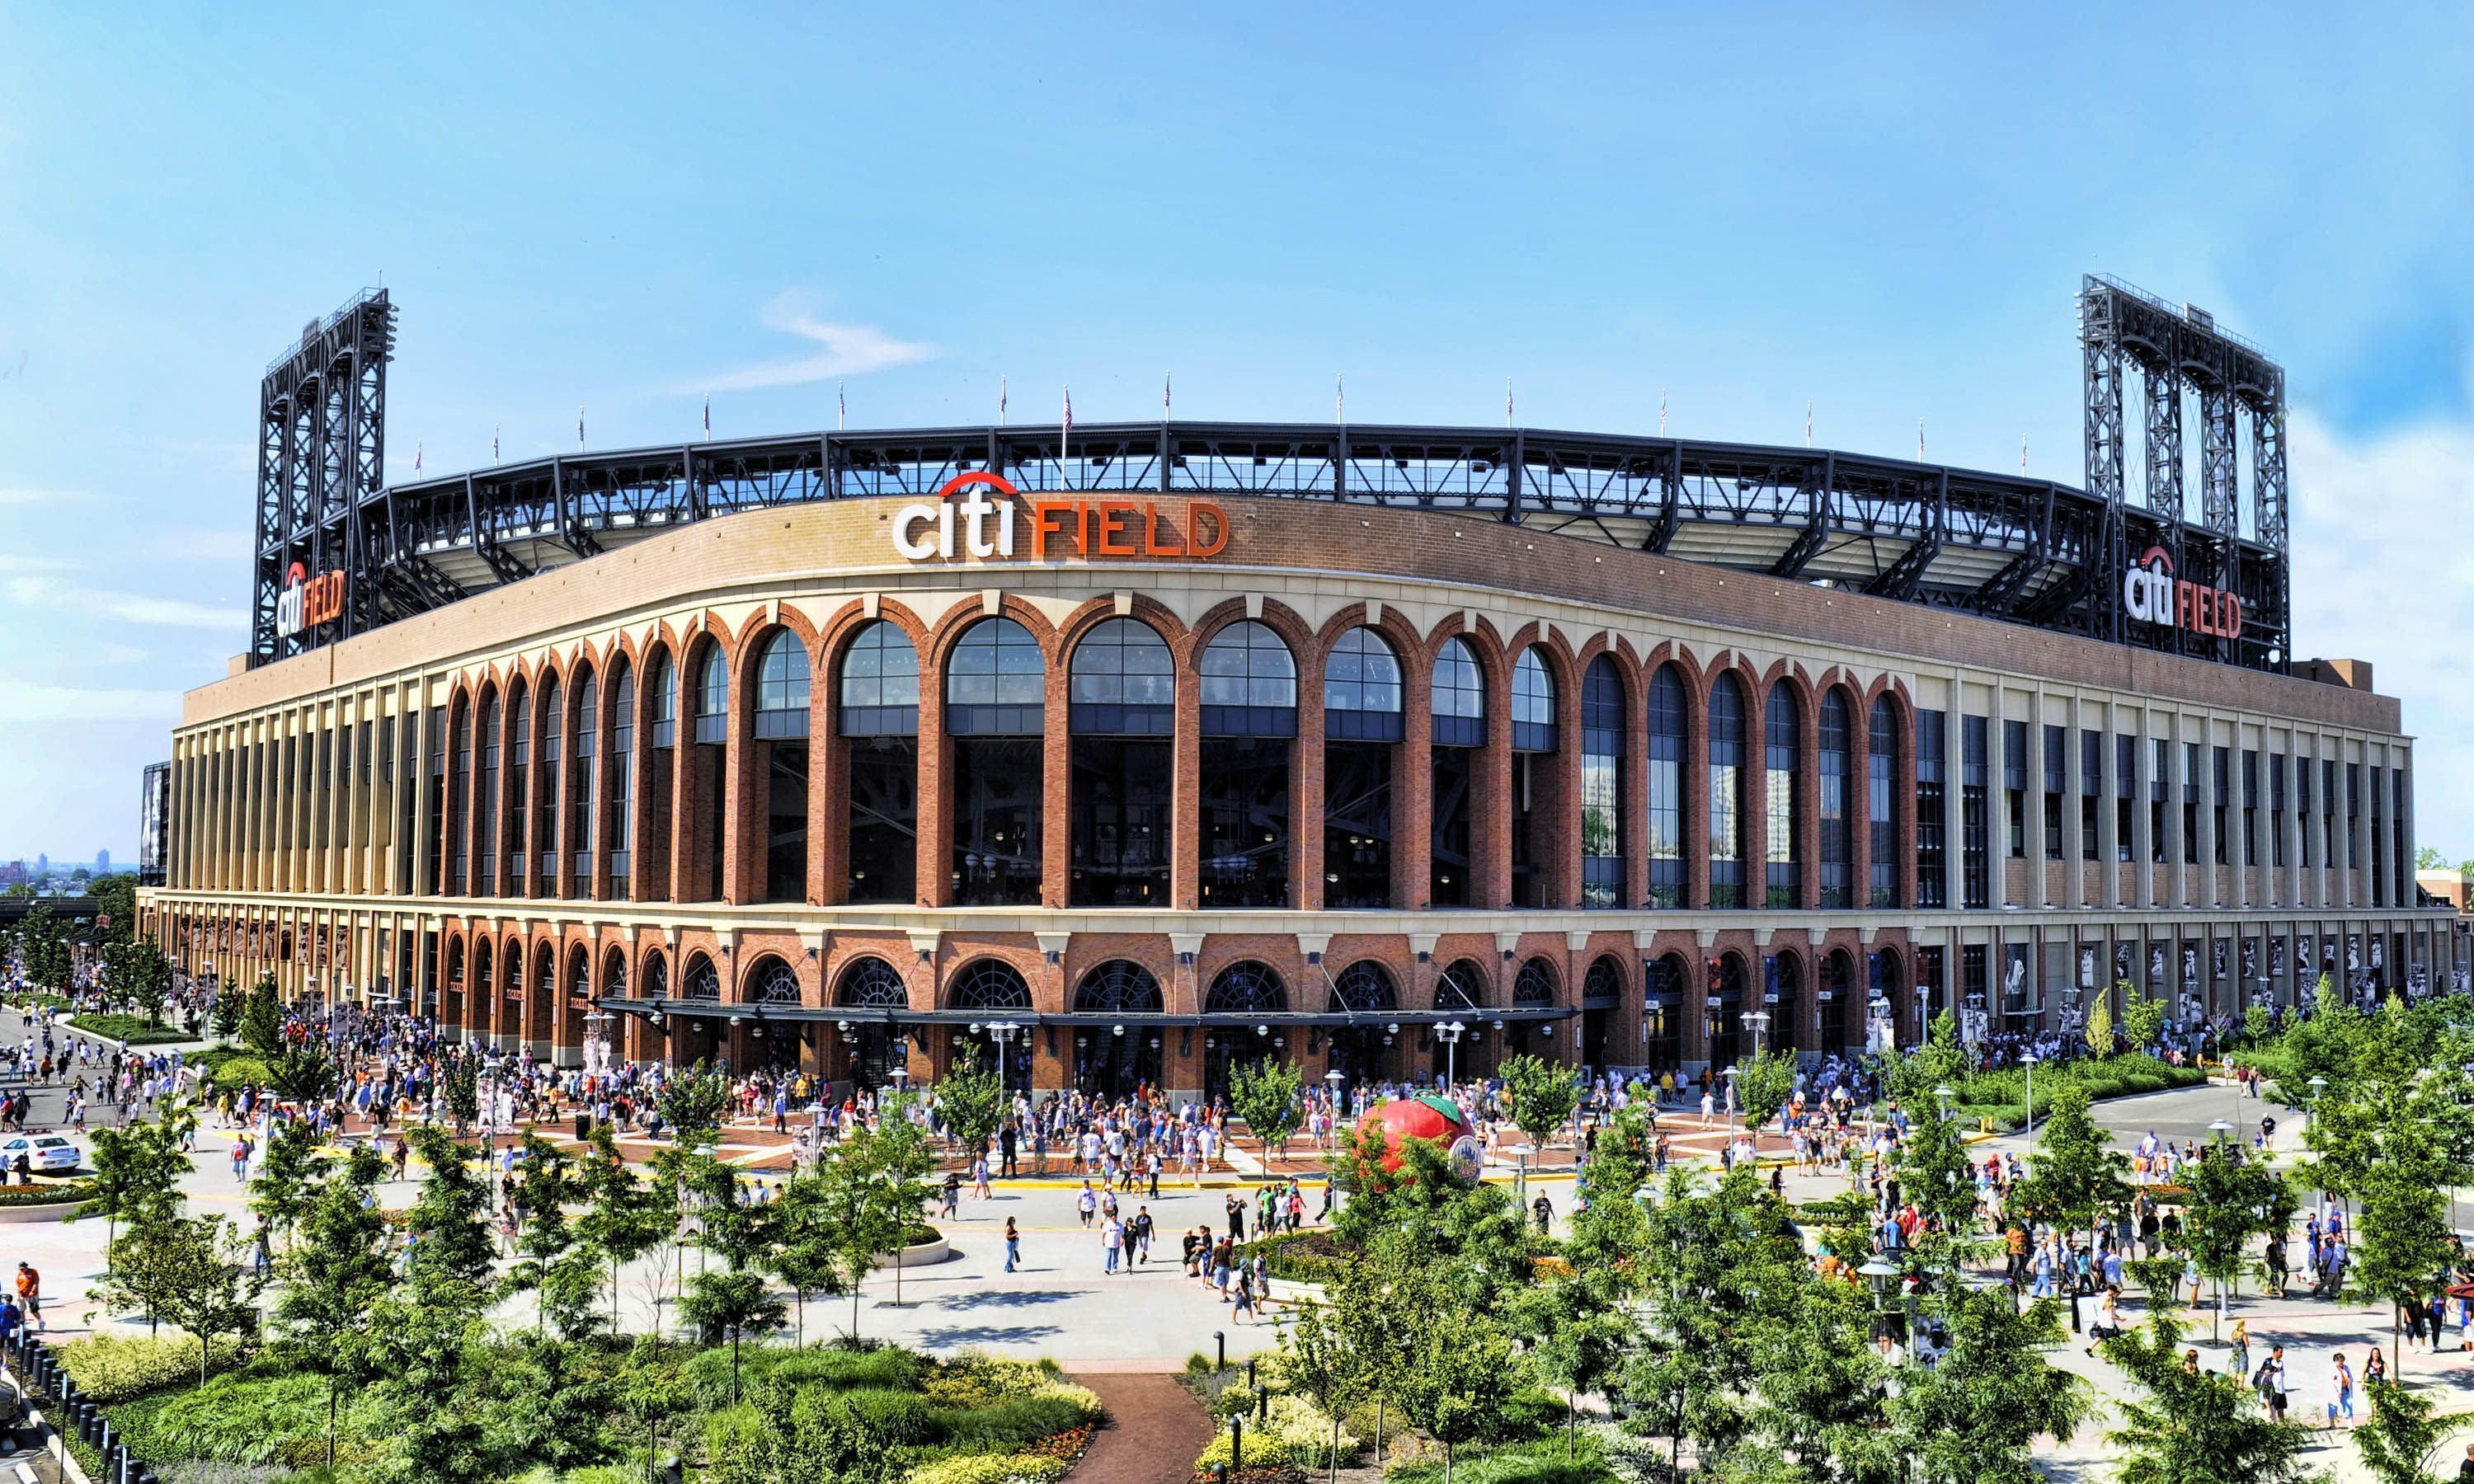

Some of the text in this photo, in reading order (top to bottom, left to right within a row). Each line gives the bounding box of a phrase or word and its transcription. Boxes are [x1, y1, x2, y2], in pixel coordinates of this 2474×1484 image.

[892, 486, 1230, 560] citi FIELD
[277, 570, 345, 637] citi FIELD
[2124, 558, 2241, 639] citi FIELD
